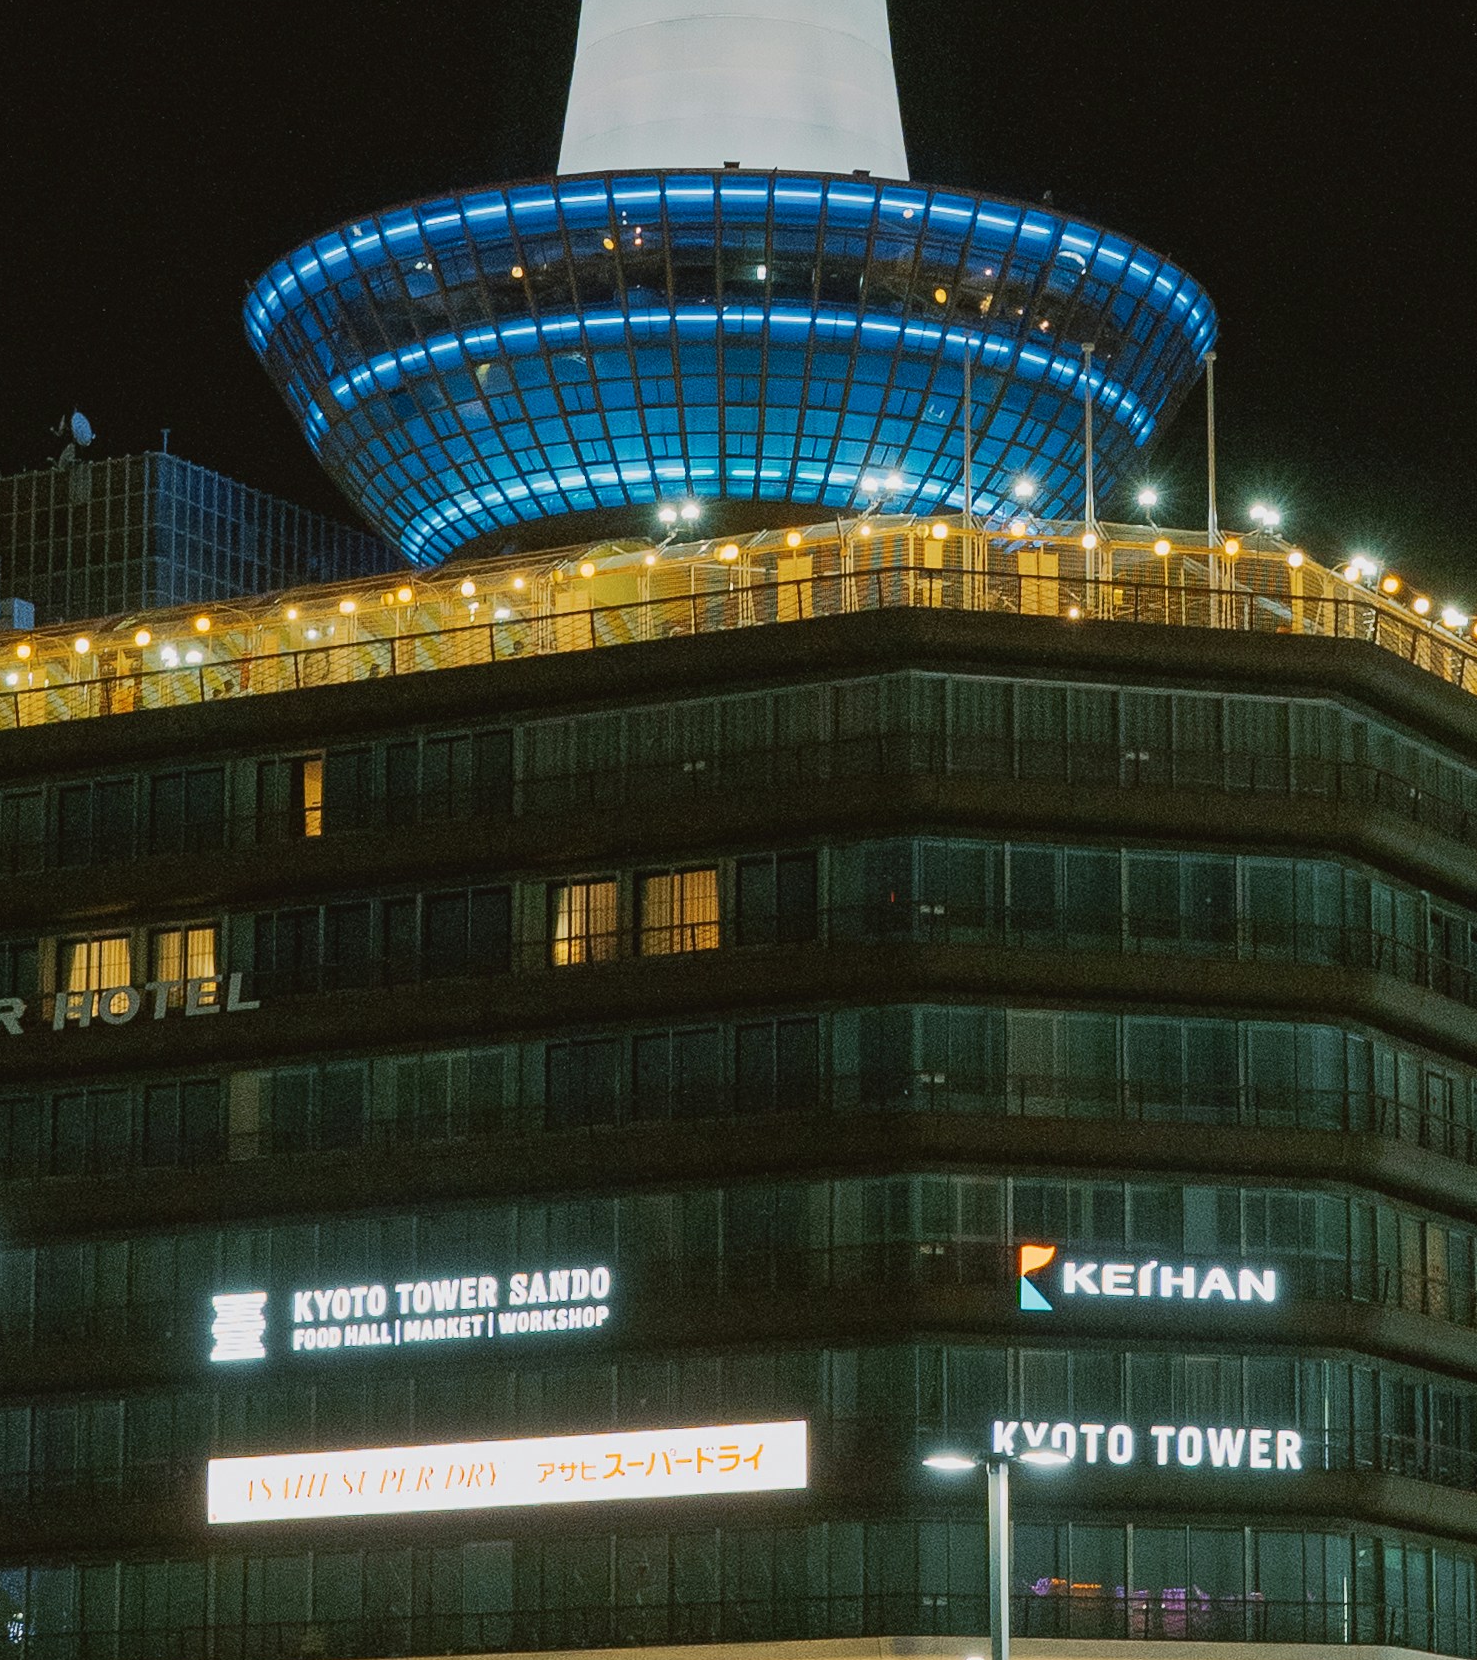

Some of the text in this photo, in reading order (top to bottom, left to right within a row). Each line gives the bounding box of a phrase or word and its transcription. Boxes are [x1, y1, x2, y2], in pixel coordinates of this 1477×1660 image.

[51, 971, 262, 1031] HOTEL
[293, 1266, 611, 1323] KYOTO TOWER SANDO
[1063, 1260, 1277, 1303] KEIHAN
[293, 1305, 610, 1351] FOOD HALL MARKET WORKSHOP
[992, 1420, 1303, 1470] KYOTO TOWER
